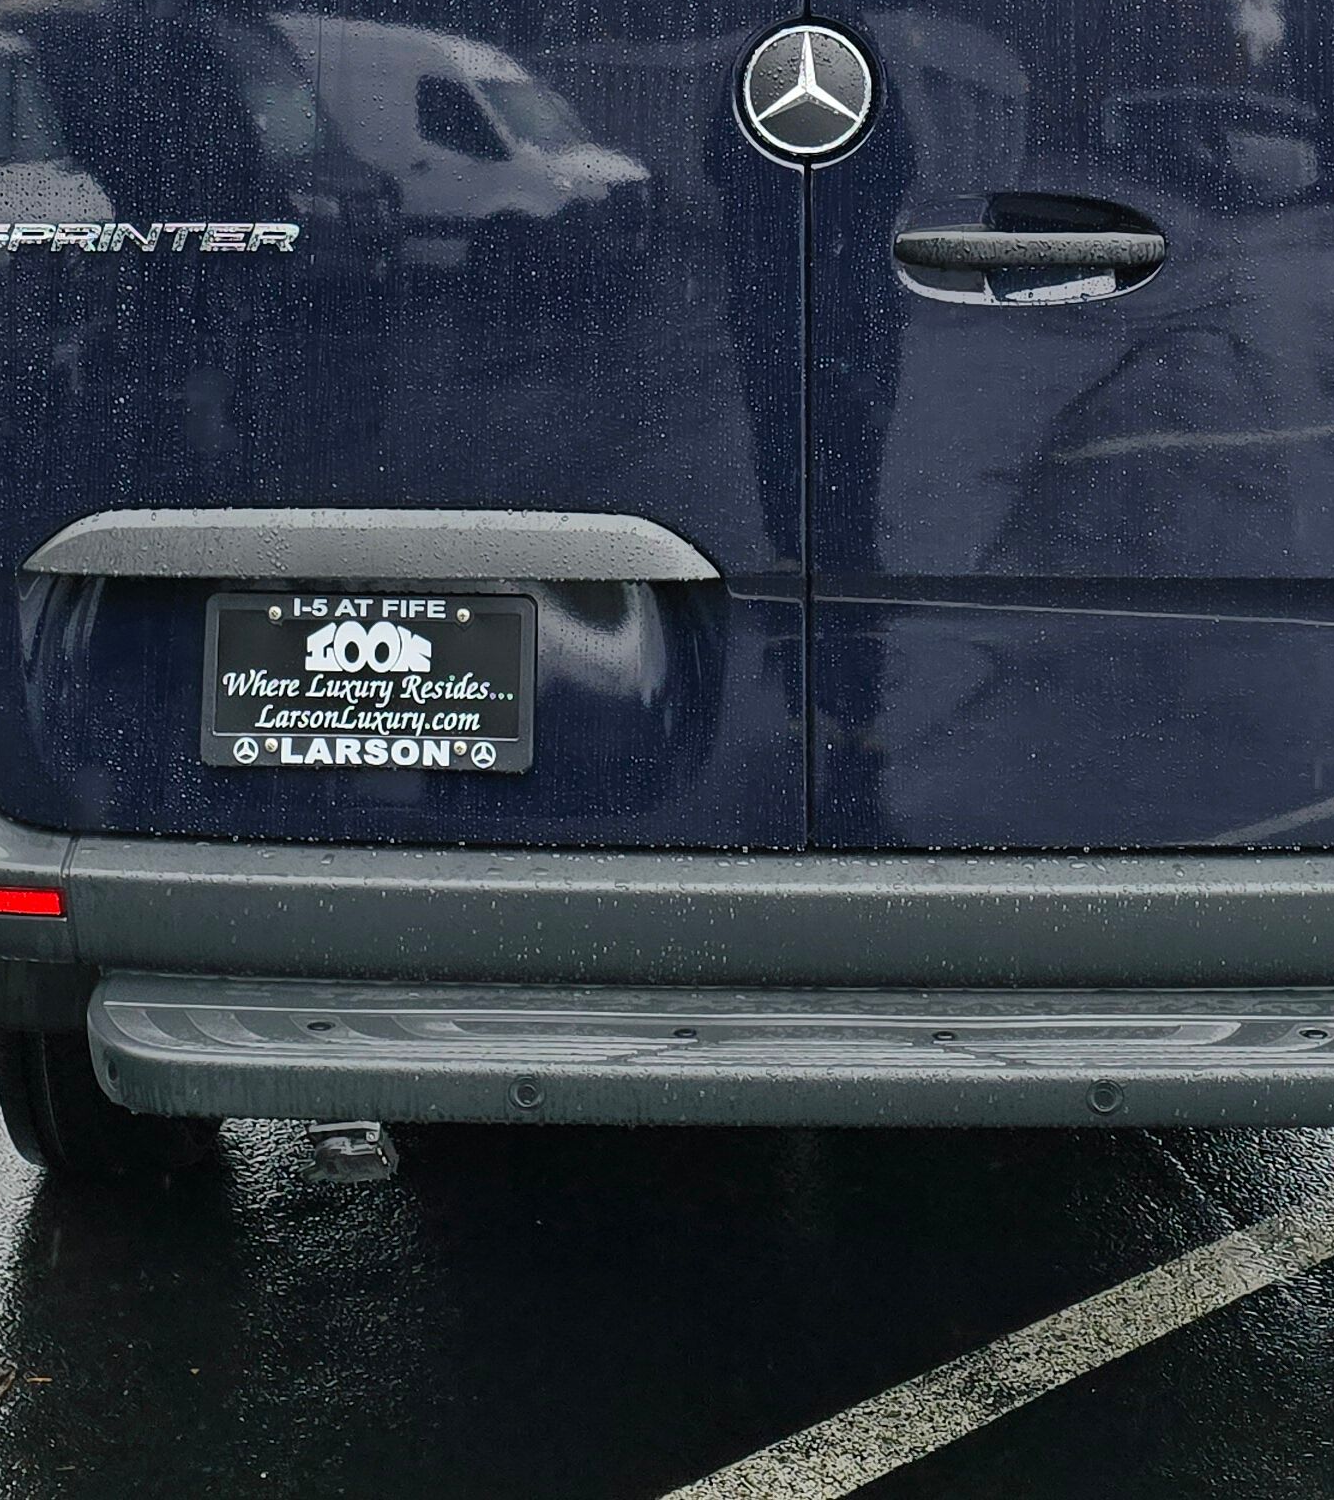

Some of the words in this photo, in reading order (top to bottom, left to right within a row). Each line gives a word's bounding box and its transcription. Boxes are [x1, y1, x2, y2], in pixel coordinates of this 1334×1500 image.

[293, 598, 328, 618] I-5
[335, 598, 373, 618] AT
[382, 599, 447, 619] FIFE
[222, 669, 299, 698] Where
[306, 673, 393, 708] Luxury
[400, 672, 514, 701] Resides...
[255, 704, 480, 736] LarsonLuxury.com
[280, 737, 451, 767] LARSON
